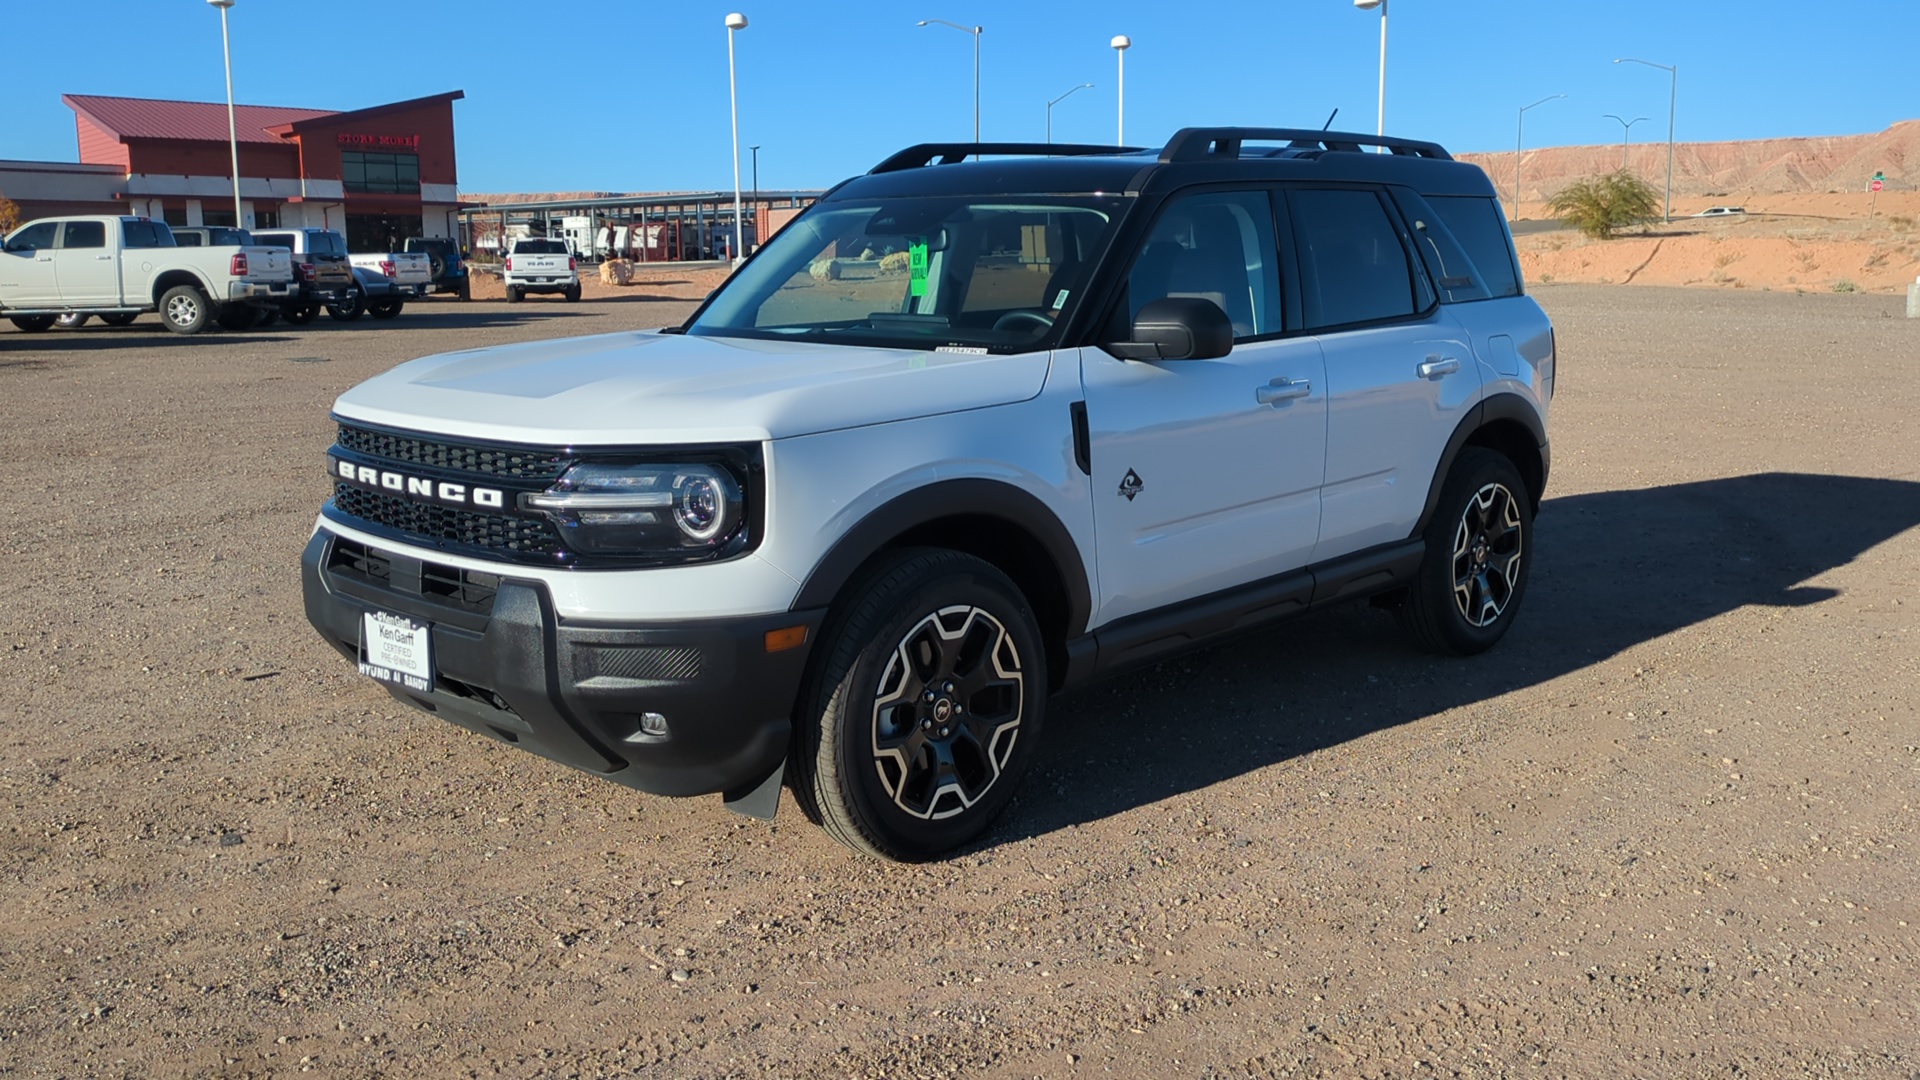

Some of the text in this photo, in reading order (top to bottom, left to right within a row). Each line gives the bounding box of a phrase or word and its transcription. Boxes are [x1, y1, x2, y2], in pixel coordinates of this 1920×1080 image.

[338, 134, 419, 151] STORE MORE!
[338, 460, 503, 508] BRONCO
[382, 611, 395, 625] Ken
[379, 624, 414, 646] Ken Garff
[383, 642, 412, 658] CERTIFIED
[381, 651, 417, 670] PRE-OWNED
[404, 674, 428, 692] SANDY
